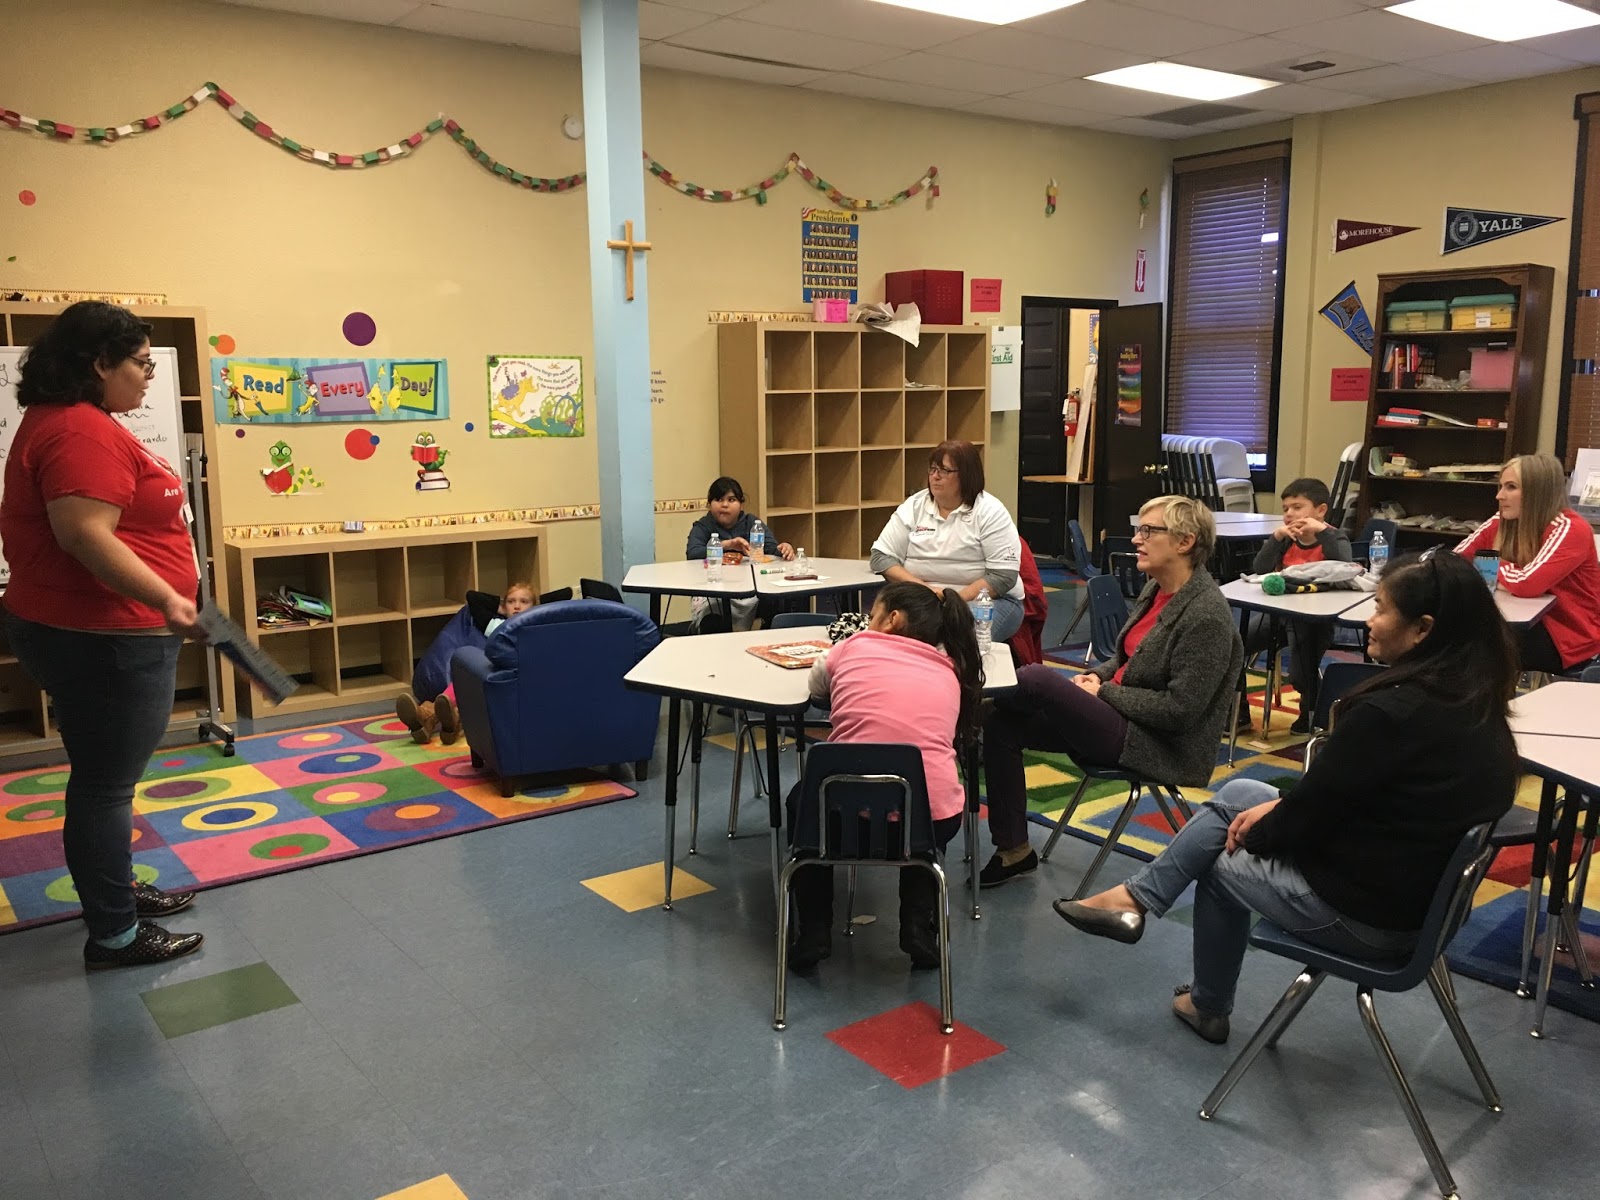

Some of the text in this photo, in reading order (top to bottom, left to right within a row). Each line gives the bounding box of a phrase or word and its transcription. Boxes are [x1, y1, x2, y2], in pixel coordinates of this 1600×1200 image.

[811, 213, 850, 223] Presidents
[1479, 217, 1523, 233] YALE
[1349, 227, 1393, 237] MOREHOUSE
[992, 353, 1013, 362] irst Aid
[242, 374, 434, 398] Read Every Day!
[164, 488, 179, 497] Are
